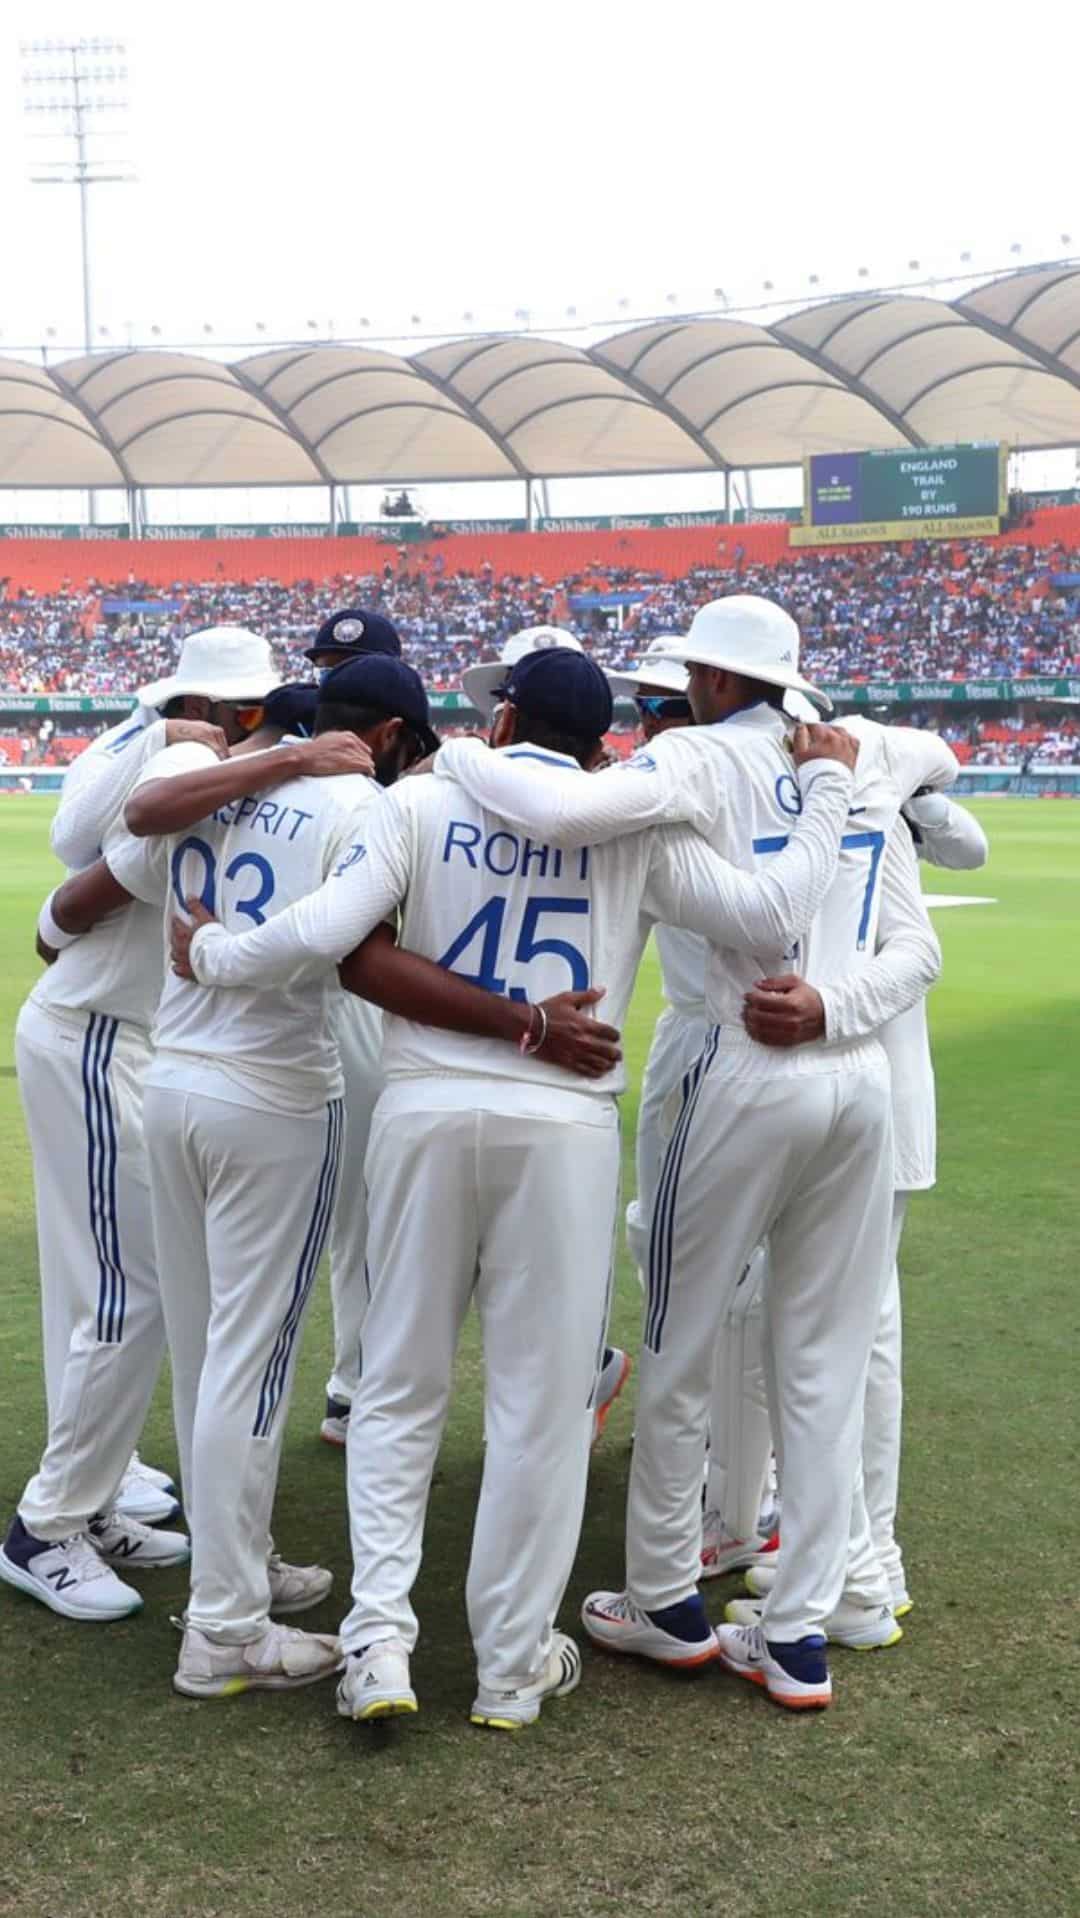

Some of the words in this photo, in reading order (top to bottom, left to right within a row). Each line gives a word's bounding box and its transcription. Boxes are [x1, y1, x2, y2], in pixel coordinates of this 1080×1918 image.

[900, 458, 959, 473] ENGLAND
[912, 475, 946, 487] TRAIL
[920, 489, 937, 501] BY
[902, 504, 922, 517] 190
[925, 502, 958, 515] RUNS
[436, 895, 590, 1003] 45
